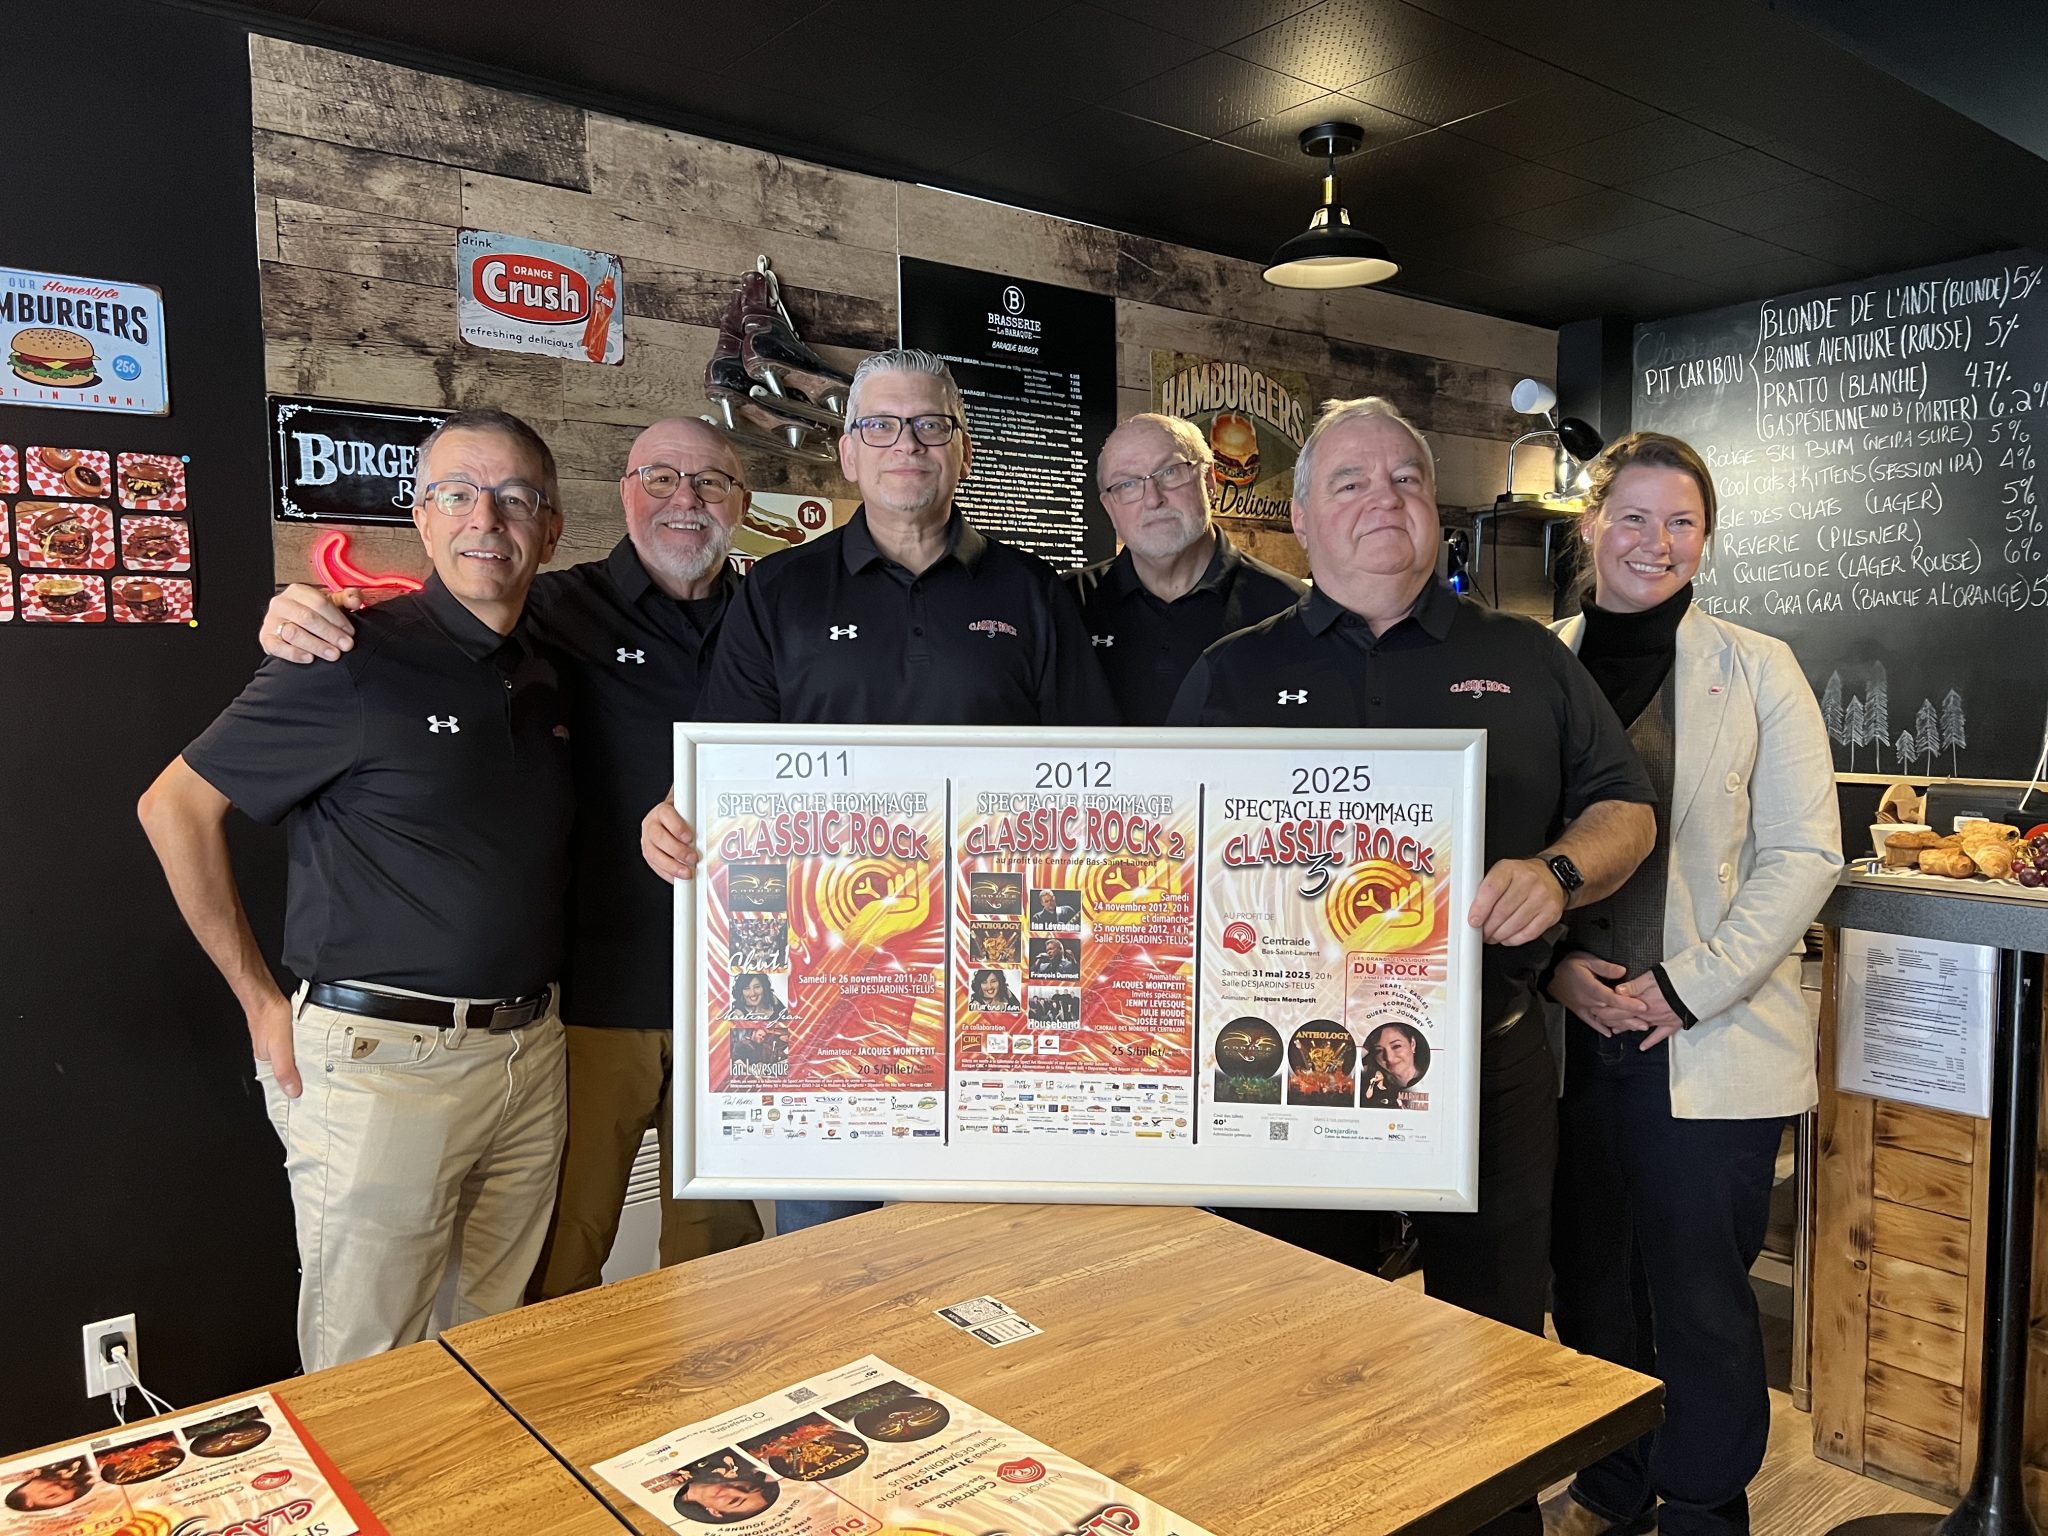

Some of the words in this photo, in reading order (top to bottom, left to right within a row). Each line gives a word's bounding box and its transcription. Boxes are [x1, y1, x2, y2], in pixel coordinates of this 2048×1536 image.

[462, 235, 492, 249] drink
[513, 265, 554, 280] ORANGE
[9, 277, 36, 290] OUR
[42, 280, 120, 300] Homestyle
[481, 260, 580, 313] Crush
[1007, 290, 1020, 310] B
[1763, 297, 1842, 341] BLONDE
[1851, 291, 1877, 326] DE
[1942, 266, 2010, 315] (BLONDE)
[2011, 265, 2043, 300] 5%
[987, 312, 1041, 332] BRASSERIE
[465, 326, 522, 344] refreshing
[528, 334, 574, 349] delicious
[1004, 327, 1033, 340] BARAQUE
[1763, 341, 1812, 374] BONNE
[1817, 325, 1897, 366] AVENTURE
[1901, 315, 1972, 359] (ROUSSE)
[1985, 313, 2020, 348] 5%
[1645, 366, 1675, 396] PIT
[1679, 353, 1743, 389] CARIBOU
[1763, 376, 1828, 409] PRATTO
[1840, 361, 1928, 402] (BLANCHE)
[1965, 361, 2012, 389] 4.7%
[39, 389, 59, 400] IN
[79, 393, 145, 407] TOWN!
[1162, 362, 1306, 448] HAMBURGERS
[1763, 404, 1869, 439] GASPÉSIENNE
[1906, 393, 1978, 424] (PORTER)
[291, 430, 421, 486] BURGE
[1766, 444, 1795, 463] SKI
[1805, 437, 1854, 459] BUM
[1800, 464, 1867, 493] KITTENS
[1868, 456, 1943, 483] (SESSION
[1949, 447, 1983, 476] IPA)
[1999, 445, 2036, 470] 4%
[1750, 507, 1785, 526] DES
[1789, 497, 1843, 521] CHATS
[1865, 481, 1943, 515] (LAGER)
[2001, 475, 2035, 505] 5%
[1723, 533, 1801, 558] REVERIE
[1817, 518, 1922, 552] (PILSNER)
[2005, 504, 2043, 533] 5%
[1733, 560, 1831, 584] QUIETUDE
[1838, 551, 1906, 579] (LAGER
[1911, 537, 1982, 577] ROUSSE)
[2004, 536, 2041, 563] 6%
[1449, 679, 1486, 693] CLASSIC
[775, 750, 849, 779] 2011
[1035, 761, 1112, 789] 2012
[1292, 765, 1371, 795] 2025
[718, 791, 827, 818] SPECTACLE
[833, 792, 928, 817] HOMMAGE
[977, 792, 1078, 815] SPECTACLE
[1084, 794, 1173, 818] HOMMAGE
[1224, 797, 1331, 823] SPECTACLE
[1339, 801, 1433, 827] HOMMAGE
[720, 809, 841, 861] CLASSIC
[849, 812, 930, 861] ROCK
[965, 806, 1079, 855] CLASSIC
[1085, 807, 1162, 856] ROCK
[1168, 831, 1185, 859] 2
[1222, 819, 1346, 866] CLASSIC
[1353, 822, 1435, 874] ROCK
[1045, 857, 1084, 866] Centraide
[1299, 852, 1333, 897] 3
[1161, 893, 1189, 902] Samedi
[1093, 902, 1103, 911] 24
[1105, 902, 1146, 912] novembre
[1172, 903, 1182, 912] 20
[971, 922, 1020, 930] ANTHOLOGY
[1031, 921, 1044, 931] Ian
[1141, 915, 1149, 923] et
[1151, 914, 1189, 924] dimanche
[1093, 924, 1103, 932] 25
[1105, 924, 1146, 933] novembre
[1172, 925, 1182, 934] 14
[1094, 934, 1113, 943] Salle
[1115, 934, 1189, 945] DESJARDINS-TELUS
[1261, 936, 1311, 947] Centraide
[1261, 948, 1320, 957] Bas-Saint-Laurent
[1222, 969, 1250, 977] Samedi
[1252, 969, 1263, 977] 31
[1265, 970, 1283, 978] mai
[1315, 972, 1325, 980] 20
[1353, 962, 1377, 974] DU
[1383, 963, 1428, 976] ROCK
[798, 974, 827, 984] Samedi
[830, 973, 835, 984] le
[838, 974, 848, 983] 26
[850, 973, 892, 983] novembre
[918, 973, 927, 982] 20
[1112, 981, 1144, 989] JACQUES
[1145, 982, 1185, 990] MONTPETIT
[1241, 981, 1315, 990] DESJARDINS-TELUS
[840, 985, 859, 994] Salle
[860, 984, 935, 994] DESJARDINS-TELUS
[1125, 999, 1148, 1007] JENNY
[1140, 1009, 1159, 1017] JULIE
[1160, 1009, 1185, 1017] HOUDE
[970, 1023, 1006, 1031] collaboration
[1028, 1019, 1080, 1029] Houseband
[1160, 1018, 1185, 1027] FORTIN
[1296, 1030, 1350, 1041] ANTHOLOGY
[817, 1048, 852, 1056] Animateur
[857, 1047, 891, 1056] JACQUES
[893, 1047, 936, 1056] MONTPETIT
[1112, 1046, 1124, 1056] 25
[730, 1058, 744, 1076] Ian
[857, 1065, 870, 1074] 20
